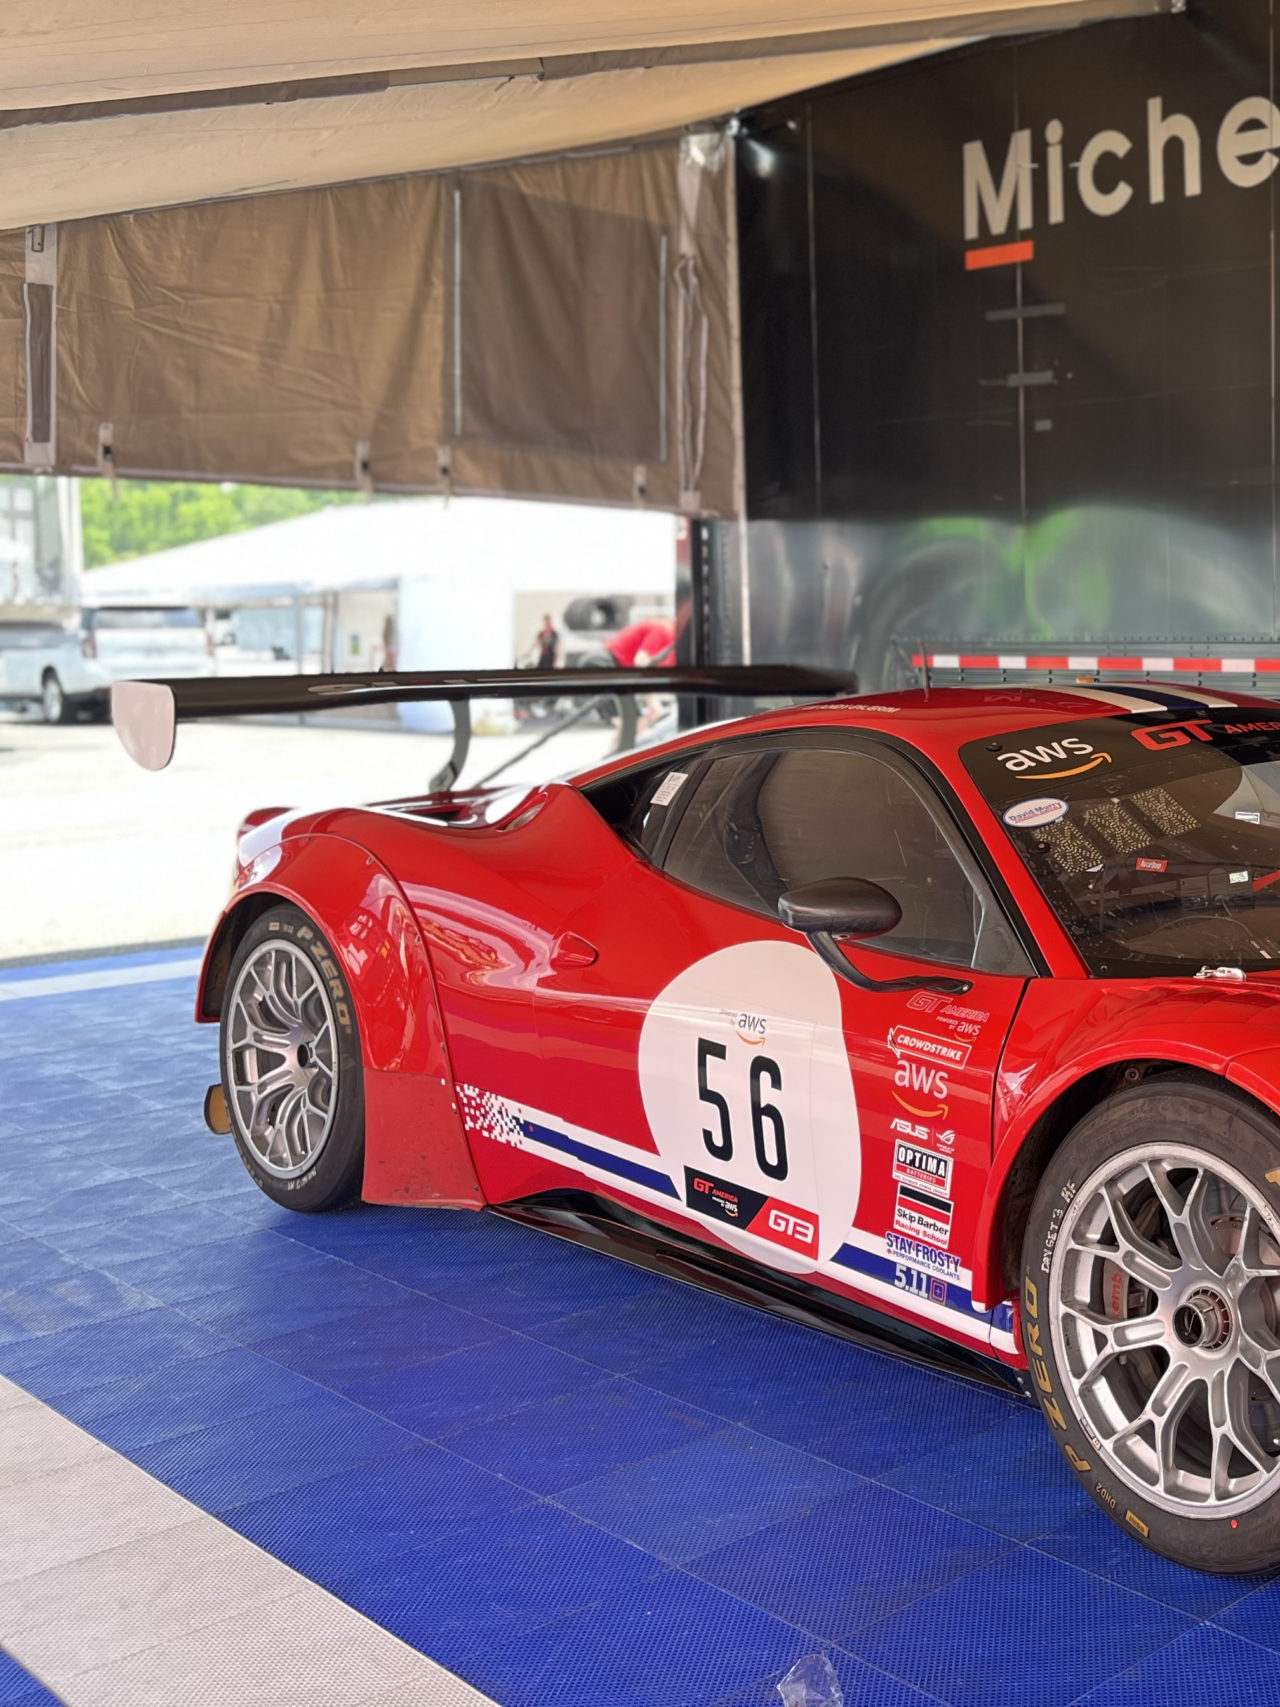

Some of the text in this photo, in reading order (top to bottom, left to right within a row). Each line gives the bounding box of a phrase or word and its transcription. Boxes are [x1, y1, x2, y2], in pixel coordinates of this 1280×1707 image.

[1130, 719, 1214, 751] GT
[996, 737, 1094, 771] aws
[1008, 809, 1034, 821] David
[1034, 802, 1062, 813] Murry
[310, 941, 351, 1026] ZERO
[906, 991, 990, 1023] GT AMERICA
[738, 1013, 767, 1034] aws
[957, 1021, 982, 1036] aws
[897, 1034, 963, 1061] CROWDSTRIKE
[894, 1059, 949, 1099] aws
[697, 1037, 789, 1182] 56
[890, 1117, 930, 1140] ASUS
[898, 1146, 946, 1177] OPTIMA
[906, 1168, 936, 1183] BATTERIES
[693, 1177, 714, 1194] GT
[711, 1189, 738, 1203] AMERICA
[724, 1201, 738, 1213] aws
[1053, 1208, 1064, 1219] 3
[768, 1209, 815, 1244] GT3
[895, 1220, 947, 1245] Racing School
[896, 1208, 948, 1236] Skip Barber
[886, 1232, 960, 1273] STAY FROSTY
[893, 1250, 960, 1280] PERFORMANCE COOLANTS
[894, 1263, 928, 1299] 5.11
[1025, 1276, 1068, 1431] ZERO
[1065, 1444, 1092, 1471] P
[1095, 1482, 1116, 1509] DHD2
